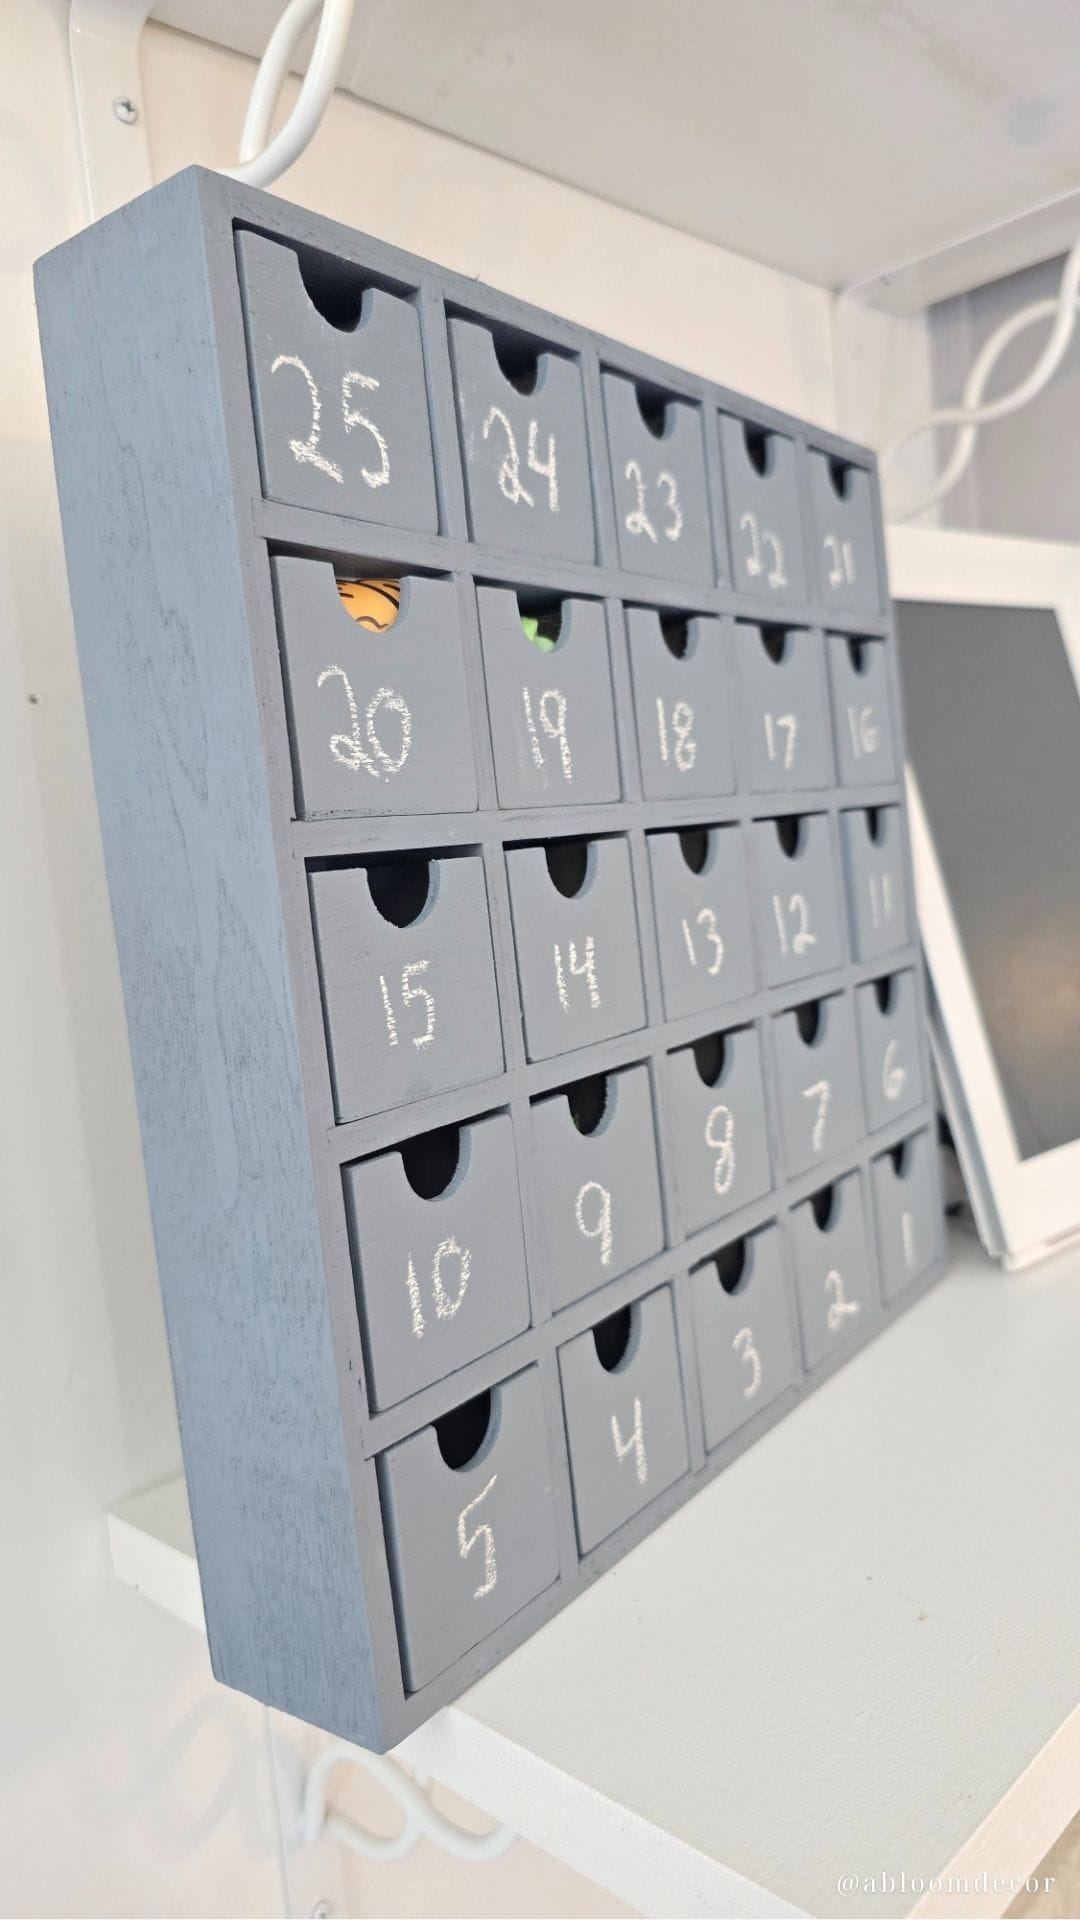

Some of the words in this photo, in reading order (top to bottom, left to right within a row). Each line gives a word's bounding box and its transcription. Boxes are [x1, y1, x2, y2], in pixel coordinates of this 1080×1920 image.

[270, 354, 391, 489] 25
[482, 405, 559, 512] 24
[624, 460, 684, 544] 23
[740, 512, 788, 590] 22
[823, 535, 855, 588] 21
[316, 664, 412, 780] 20
[522, 686, 574, 783] 19
[656, 697, 697, 772] 18
[764, 713, 798, 770] 17
[847, 706, 879, 758] 16
[772, 892, 818, 957] 12
[867, 876, 892, 928] 11
[553, 936, 602, 1010] 14
[681, 908, 725, 976] 13
[379, 959, 436, 1047] 15
[882, 1040, 906, 1101] 6
[704, 1104, 736, 1194] 8
[802, 1080, 830, 1151] 7
[575, 1180, 613, 1266] 9
[902, 1212, 912, 1266] 1
[405, 1236, 471, 1339] 10
[825, 1270, 863, 1331] 2
[732, 1327, 762, 1397] 3
[610, 1397, 648, 1484] 4
[456, 1474, 498, 1598] 5
